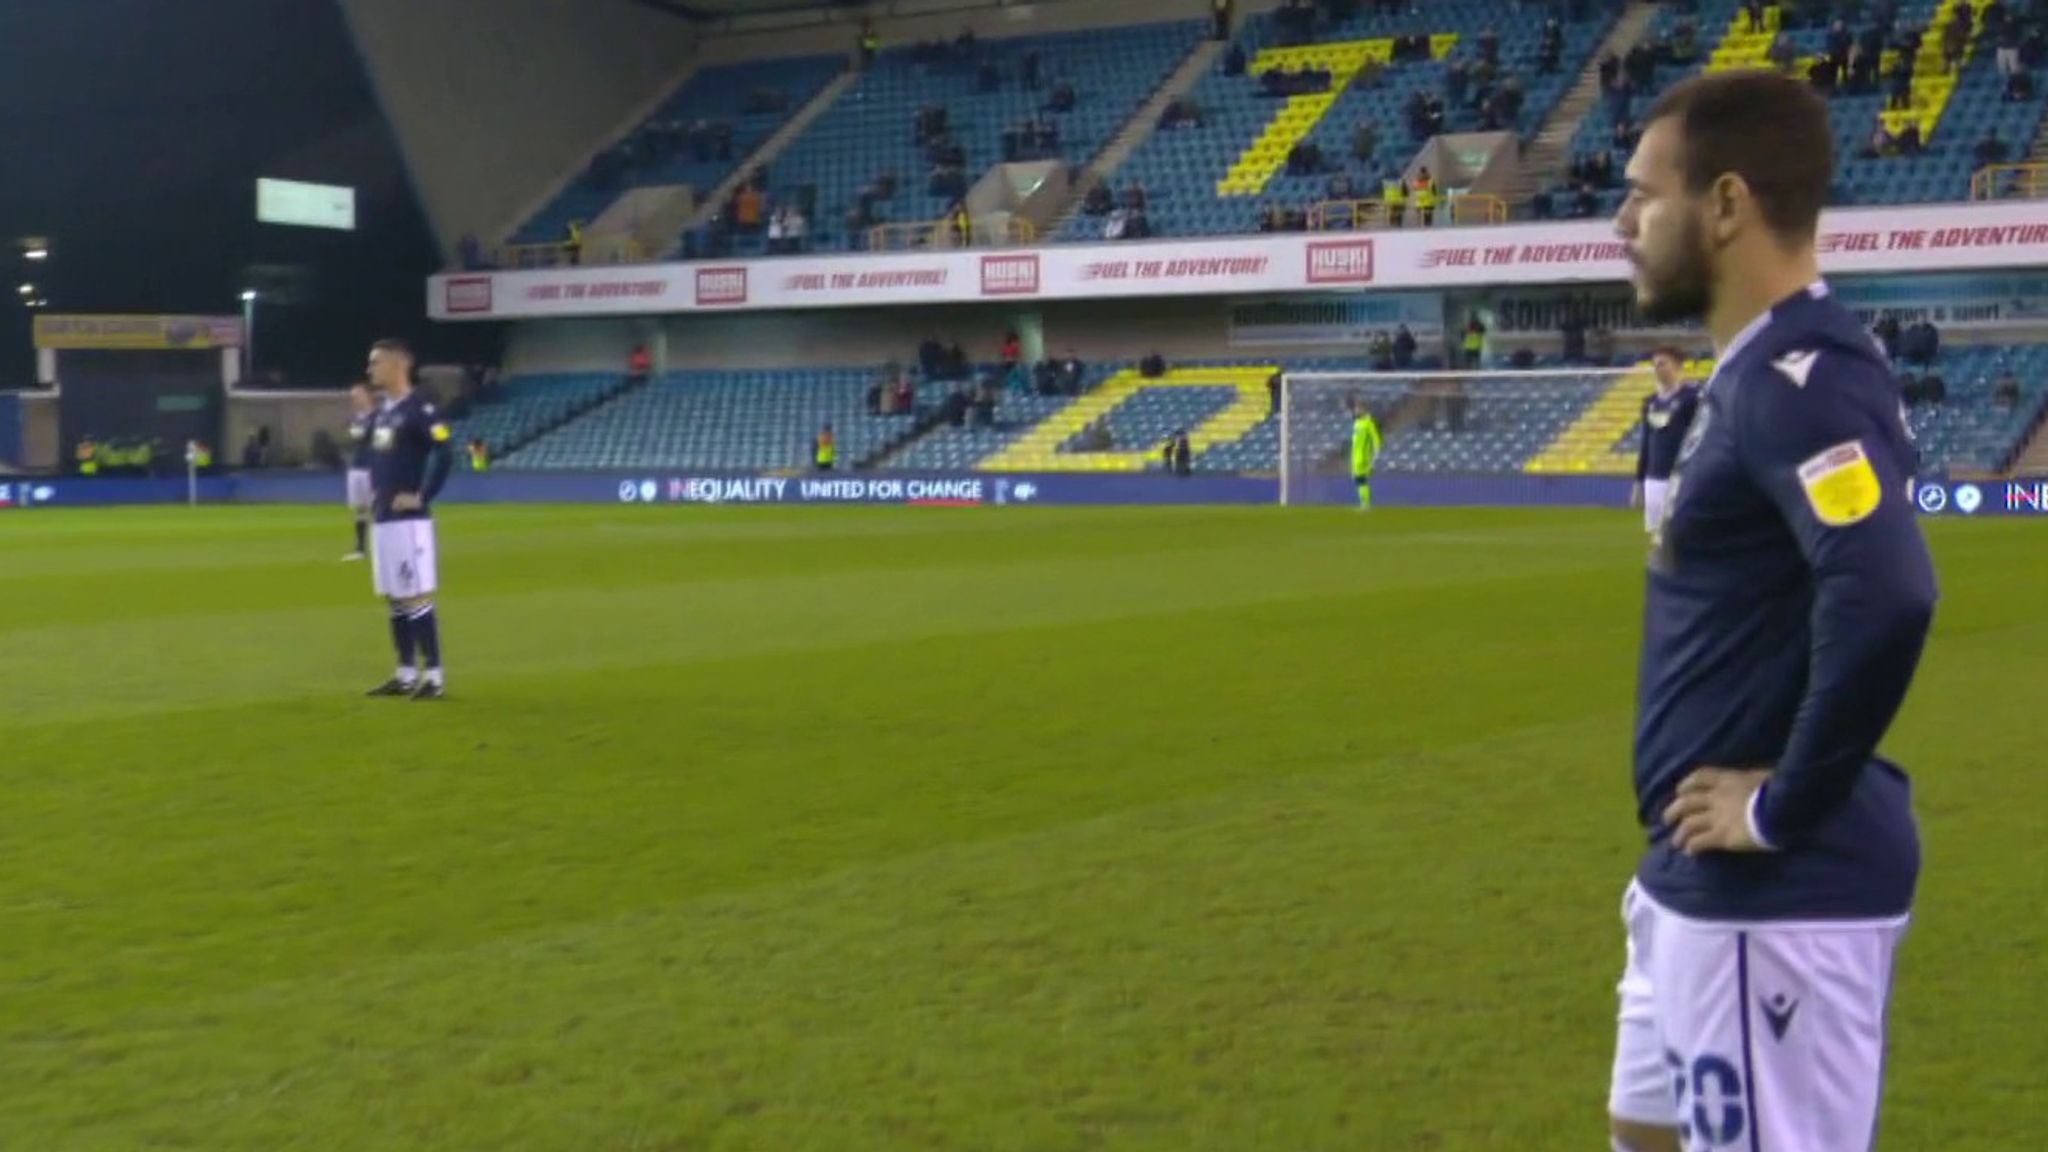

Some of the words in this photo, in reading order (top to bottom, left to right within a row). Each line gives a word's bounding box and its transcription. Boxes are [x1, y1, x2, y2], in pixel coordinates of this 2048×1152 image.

[1832, 233, 1879, 250] FUEL
[1886, 230, 1927, 248] THE
[1312, 247, 1368, 266] HUSKI
[1435, 248, 1477, 266] FUEL
[1484, 246, 1515, 264] THE
[1093, 261, 1127, 279] FUEL
[1134, 260, 1161, 277] THE
[1165, 256, 1268, 276] ADVENTURE!
[792, 274, 825, 290] FUEL
[831, 272, 854, 288] THE
[858, 269, 948, 288] ADVENTURE!
[801, 481, 860, 499] UNITED
[868, 481, 900, 498] FOR
[907, 480, 982, 498] CHANGE
